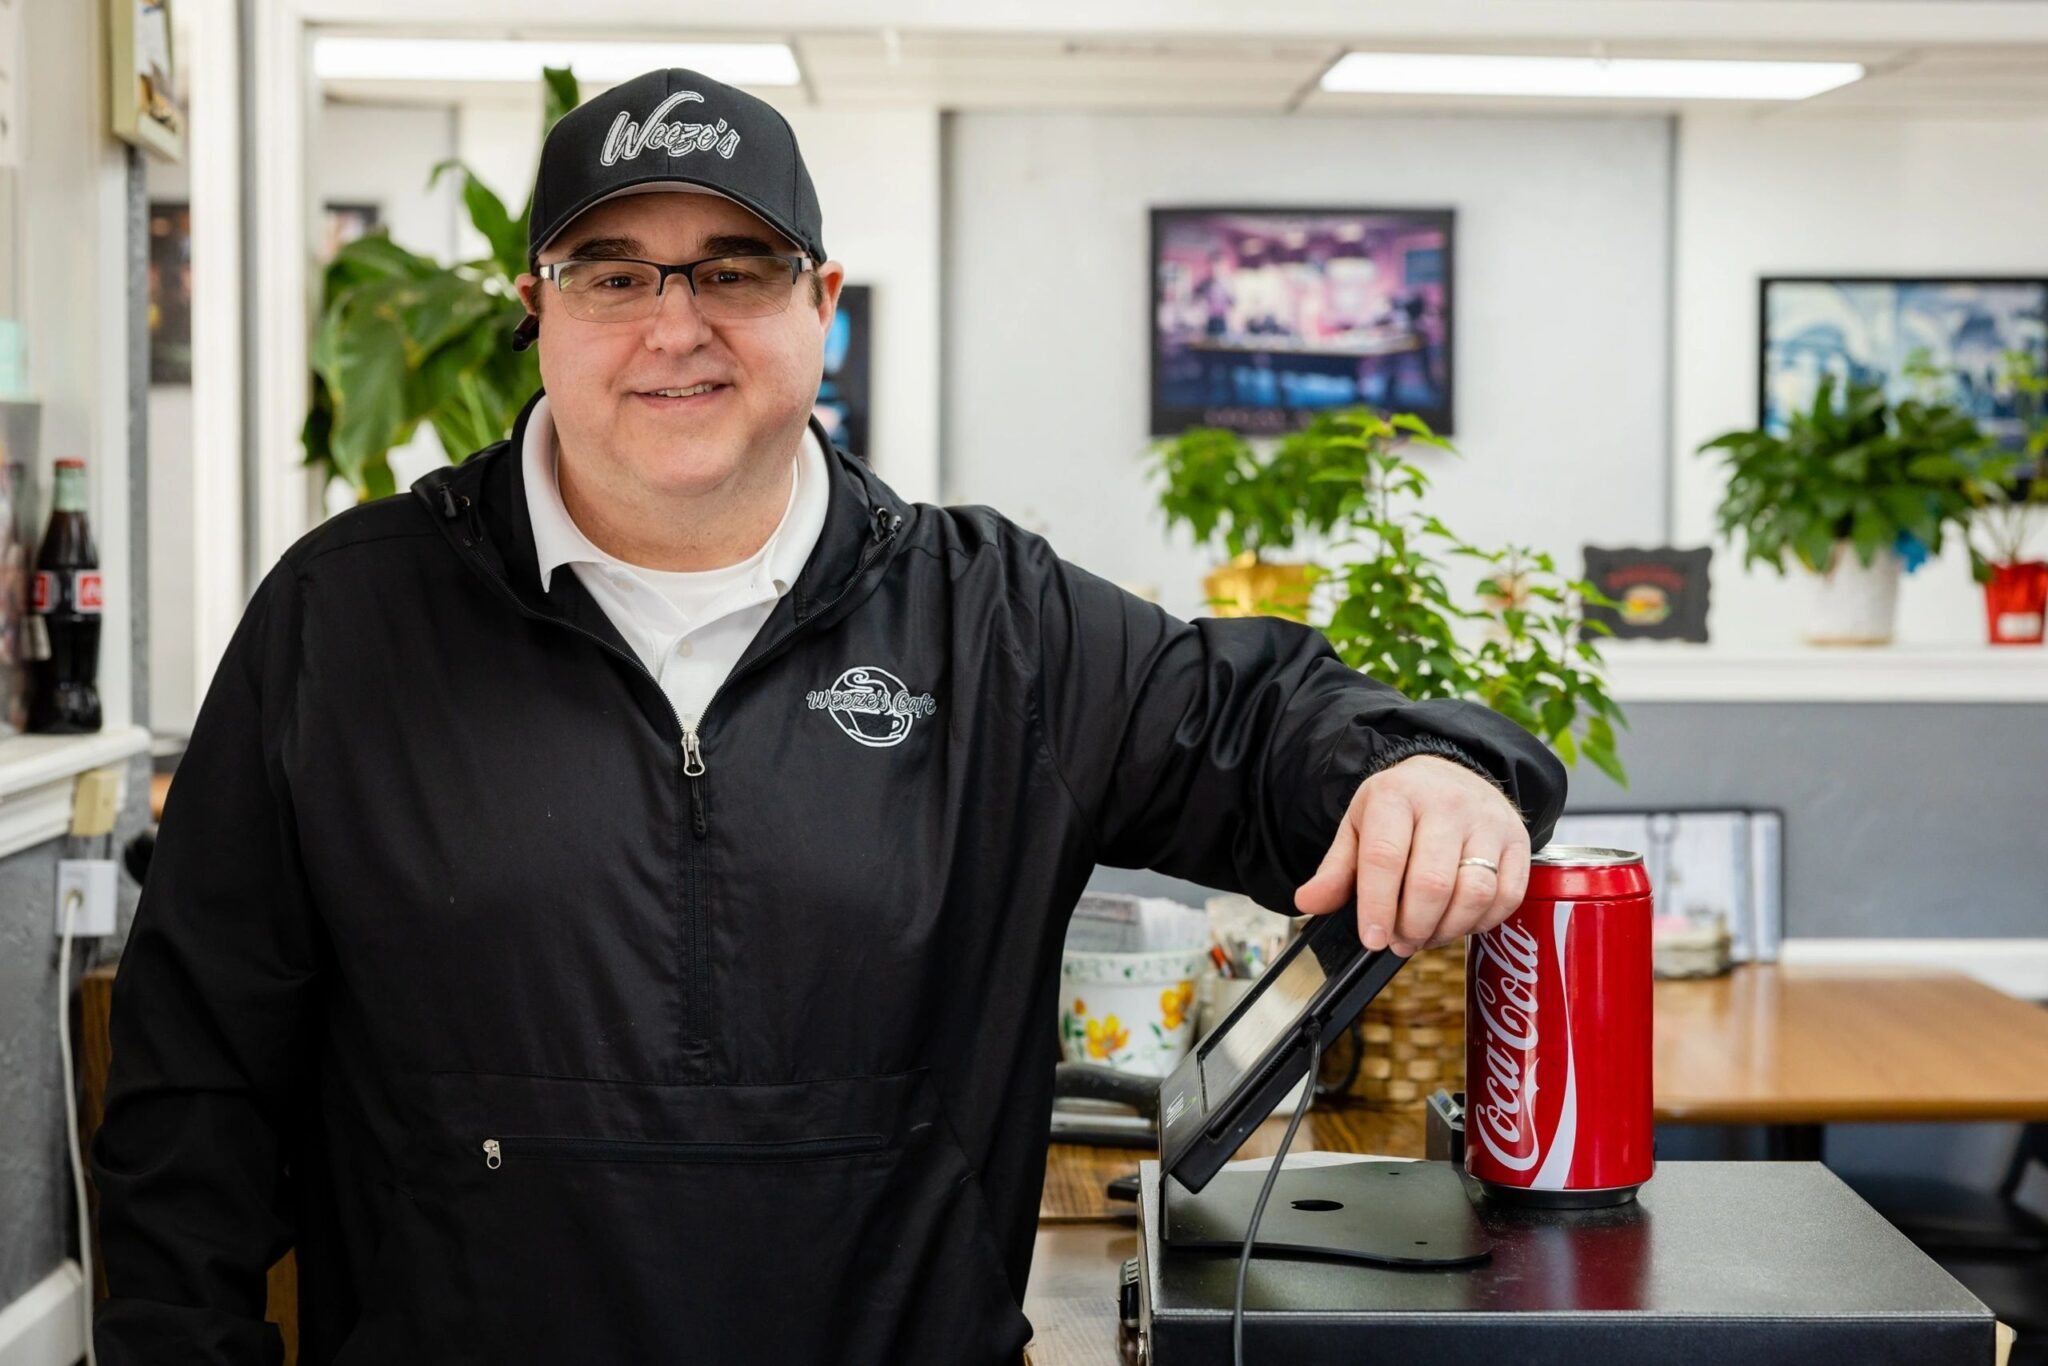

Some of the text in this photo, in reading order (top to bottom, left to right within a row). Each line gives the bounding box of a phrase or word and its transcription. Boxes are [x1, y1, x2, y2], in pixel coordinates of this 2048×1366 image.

[600, 90, 741, 167] Weeze's
[806, 689, 891, 712] Weeze's
[1475, 921, 1539, 1171] Coca-Cola
